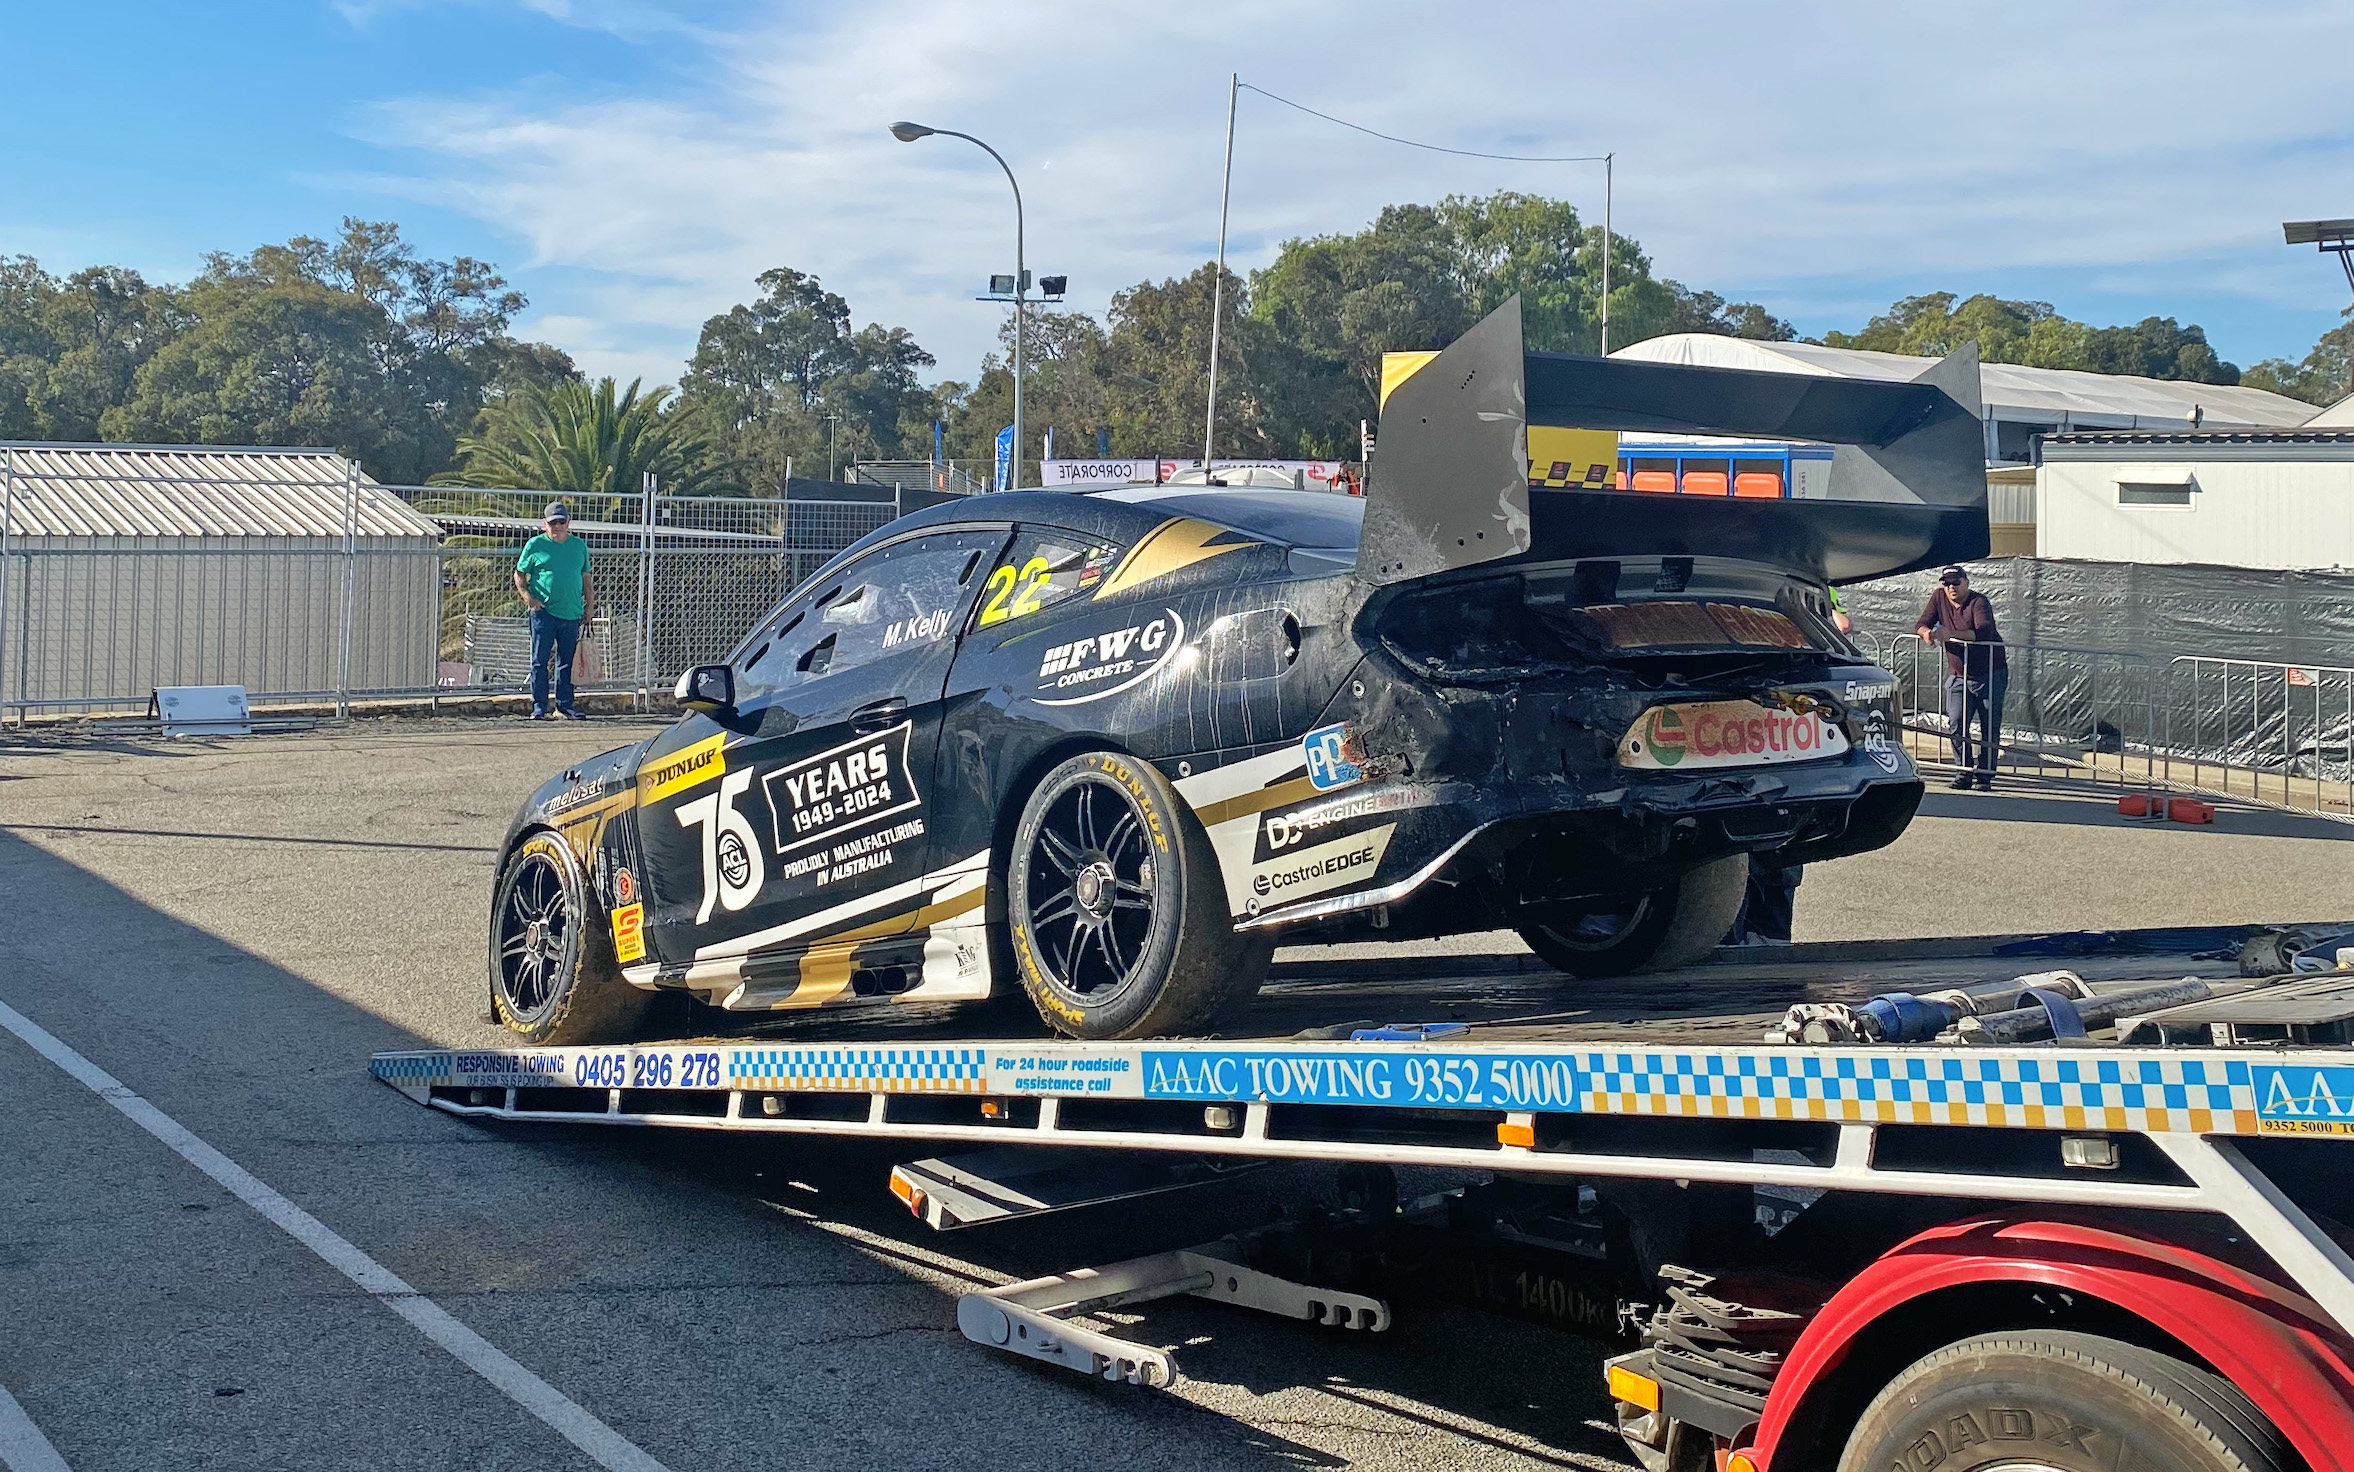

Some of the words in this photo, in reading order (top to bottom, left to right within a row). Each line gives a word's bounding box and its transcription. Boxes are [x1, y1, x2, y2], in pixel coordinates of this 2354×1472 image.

[979, 555, 1051, 626] 22
[882, 621, 902, 648] M.
[904, 608, 952, 642] Kelly
[1057, 659, 1135, 688] CONCRETE
[1844, 680, 1891, 704] Snap-on
[1694, 709, 1821, 757] Castrol
[1864, 733, 1892, 753] ACL
[656, 747, 717, 787] DUNLOP
[785, 743, 889, 809] YEARS
[791, 780, 892, 833] 1949-2024
[673, 765, 765, 926] 75
[722, 850, 748, 872] ACL
[783, 850, 829, 880] PROUDLY
[833, 818, 925, 862] MANUFACTURING
[816, 869, 829, 887] IN
[830, 848, 893, 882] AUSTRALIA
[1271, 863, 1324, 889] Castrol
[1324, 846, 1375, 874] EDGE
[456, 1055, 519, 1074] RESPONSIVE
[523, 1054, 565, 1074] TOWING
[575, 1054, 625, 1087] 0405
[632, 1053, 673, 1087] 296
[680, 1052, 720, 1087] 278
[995, 1057, 1016, 1070] For
[1019, 1057, 1035, 1070] 24
[1038, 1057, 1068, 1071] hour
[1071, 1058, 1130, 1072] roadside
[1015, 1076, 1084, 1091] assistance
[1088, 1077, 1111, 1091] call
[1148, 1057, 1239, 1096] AAAC
[1244, 1057, 1393, 1099] TOWING
[1404, 1057, 1483, 1103] 9352
[1489, 1059, 1573, 1107] 5000
[2261, 1069, 2354, 1117] AA
[2265, 1120, 2297, 1132] 9352
[2300, 1121, 2333, 1133] 5000
